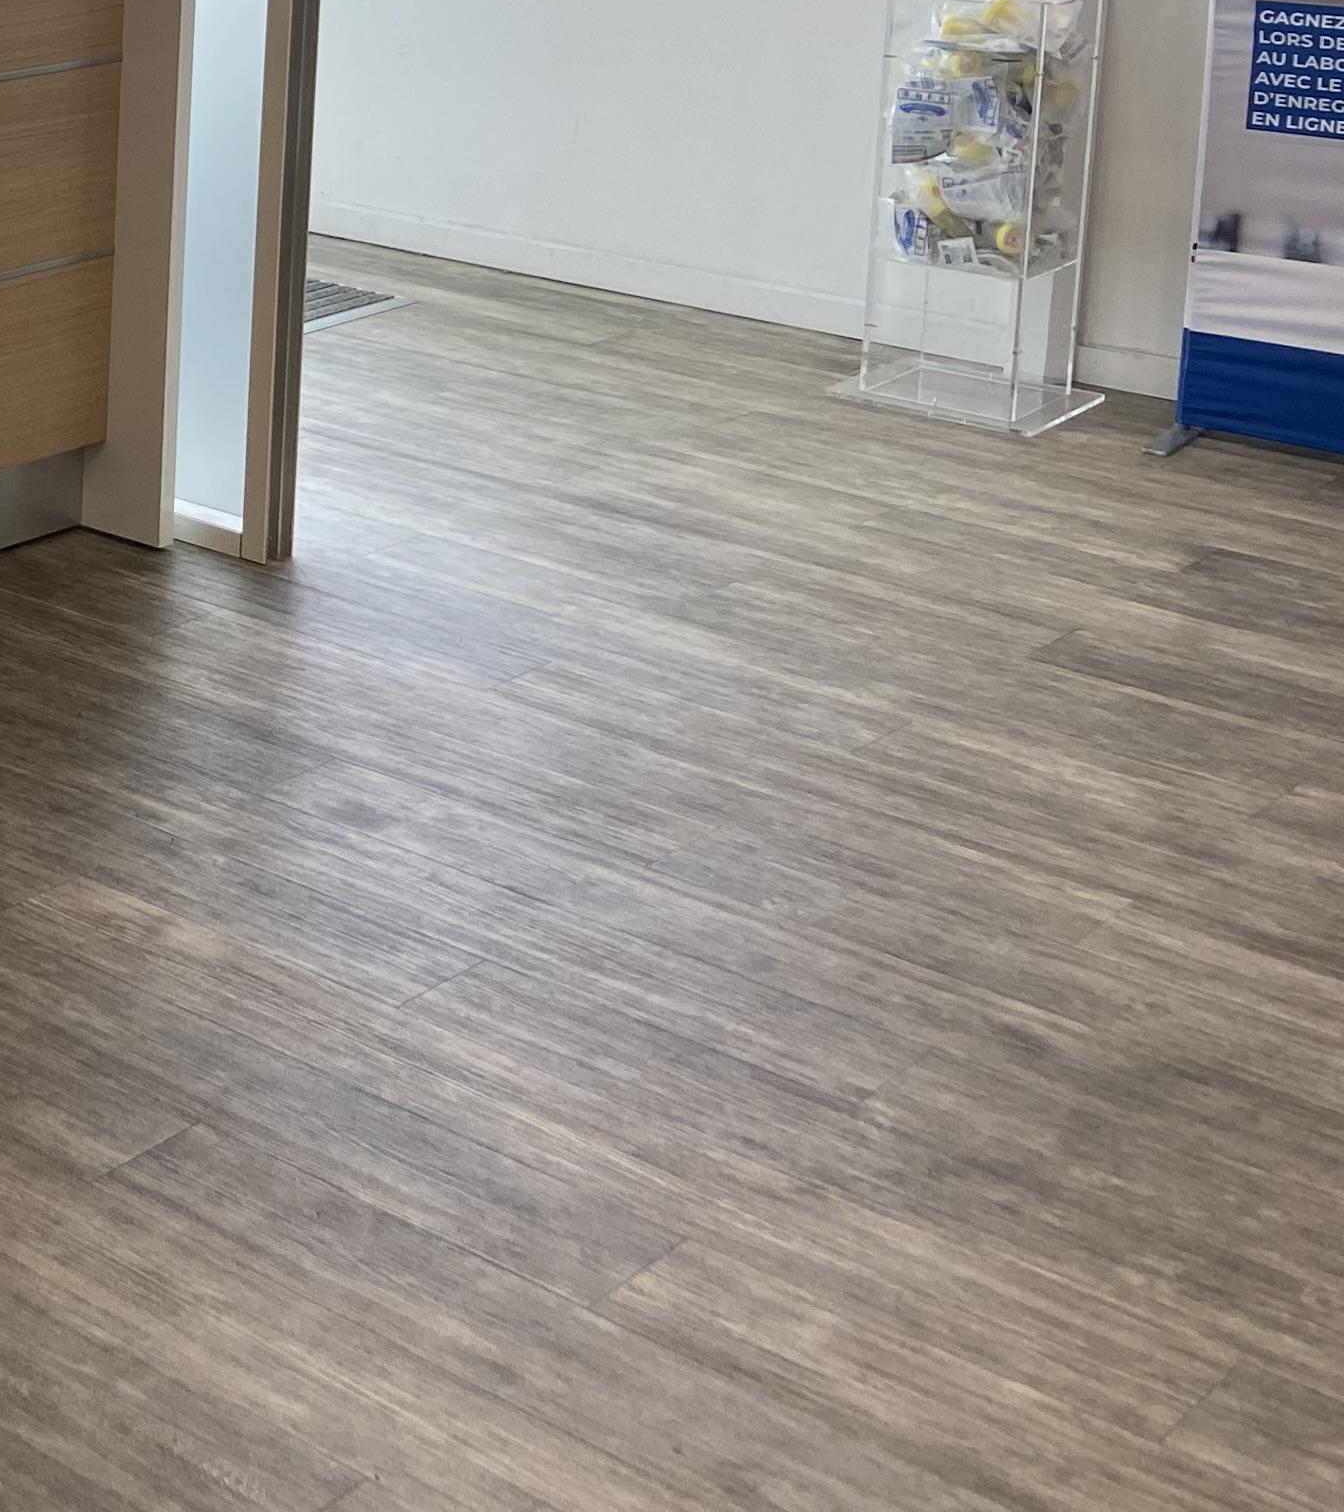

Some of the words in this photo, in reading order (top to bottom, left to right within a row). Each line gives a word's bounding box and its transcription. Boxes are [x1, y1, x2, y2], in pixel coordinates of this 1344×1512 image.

[1260, 9, 1344, 30] GAGNEZ
[1259, 30, 1314, 48] LORS
[1256, 50, 1287, 66] AU
[1254, 71, 1312, 89] AVEC
[1317, 77, 1343, 93] LE
[1253, 91, 1344, 114] D'ENREG
[1252, 111, 1280, 127] EN
[1286, 115, 1344, 134] LIGNE
